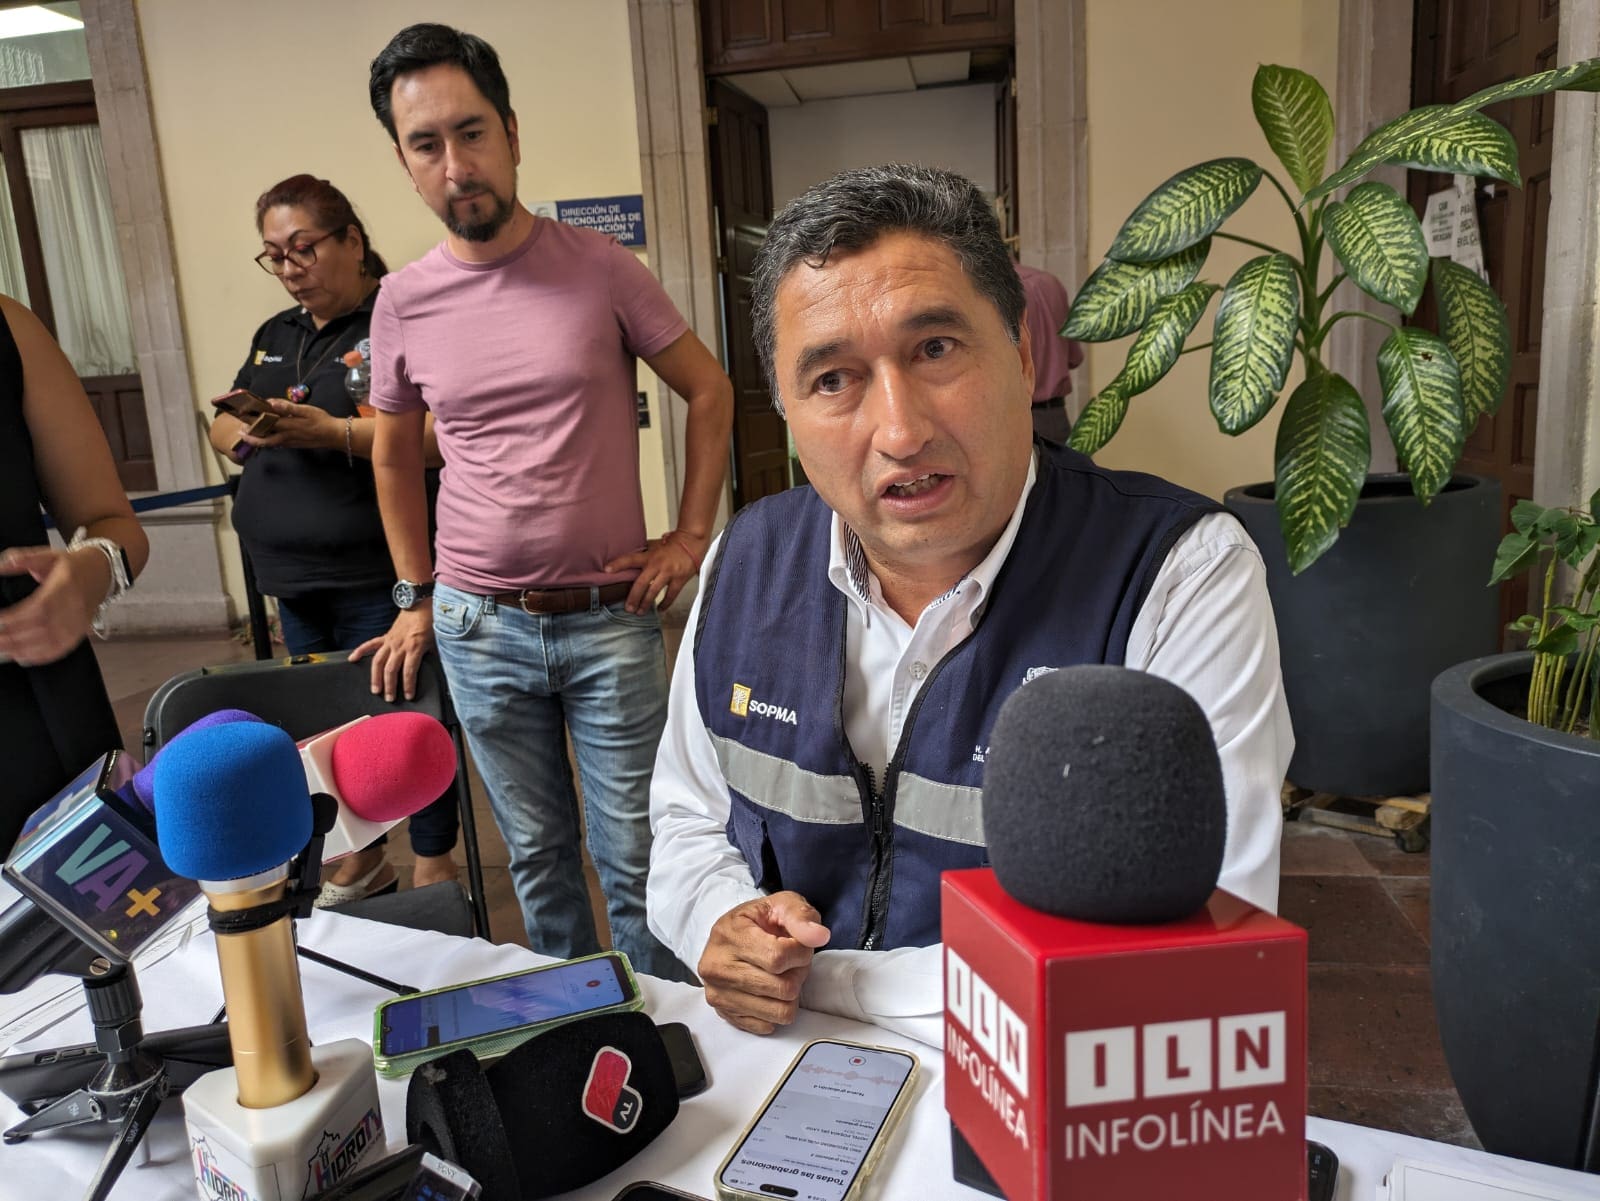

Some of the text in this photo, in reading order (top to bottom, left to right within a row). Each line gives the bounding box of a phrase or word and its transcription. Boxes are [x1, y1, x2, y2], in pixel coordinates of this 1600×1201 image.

[561, 205, 620, 217] DIRECCIÓN DE
[628, 212, 641, 221] DE
[628, 222, 635, 231] Y
[749, 700, 797, 725] SOPMA
[953, 962, 1022, 1076] ILN
[1092, 1024, 1271, 1090] ILN
[948, 1022, 1029, 1150] INFOLÍNEA
[620, 1102, 633, 1122] TV
[1065, 1100, 1286, 1160] INFOLÍNEA
[196, 1147, 257, 1201] HIDROT
[740, 1158, 800, 1175] grabaciones
[800, 1170, 816, 1180] las
[815, 1174, 844, 1186] Todas
